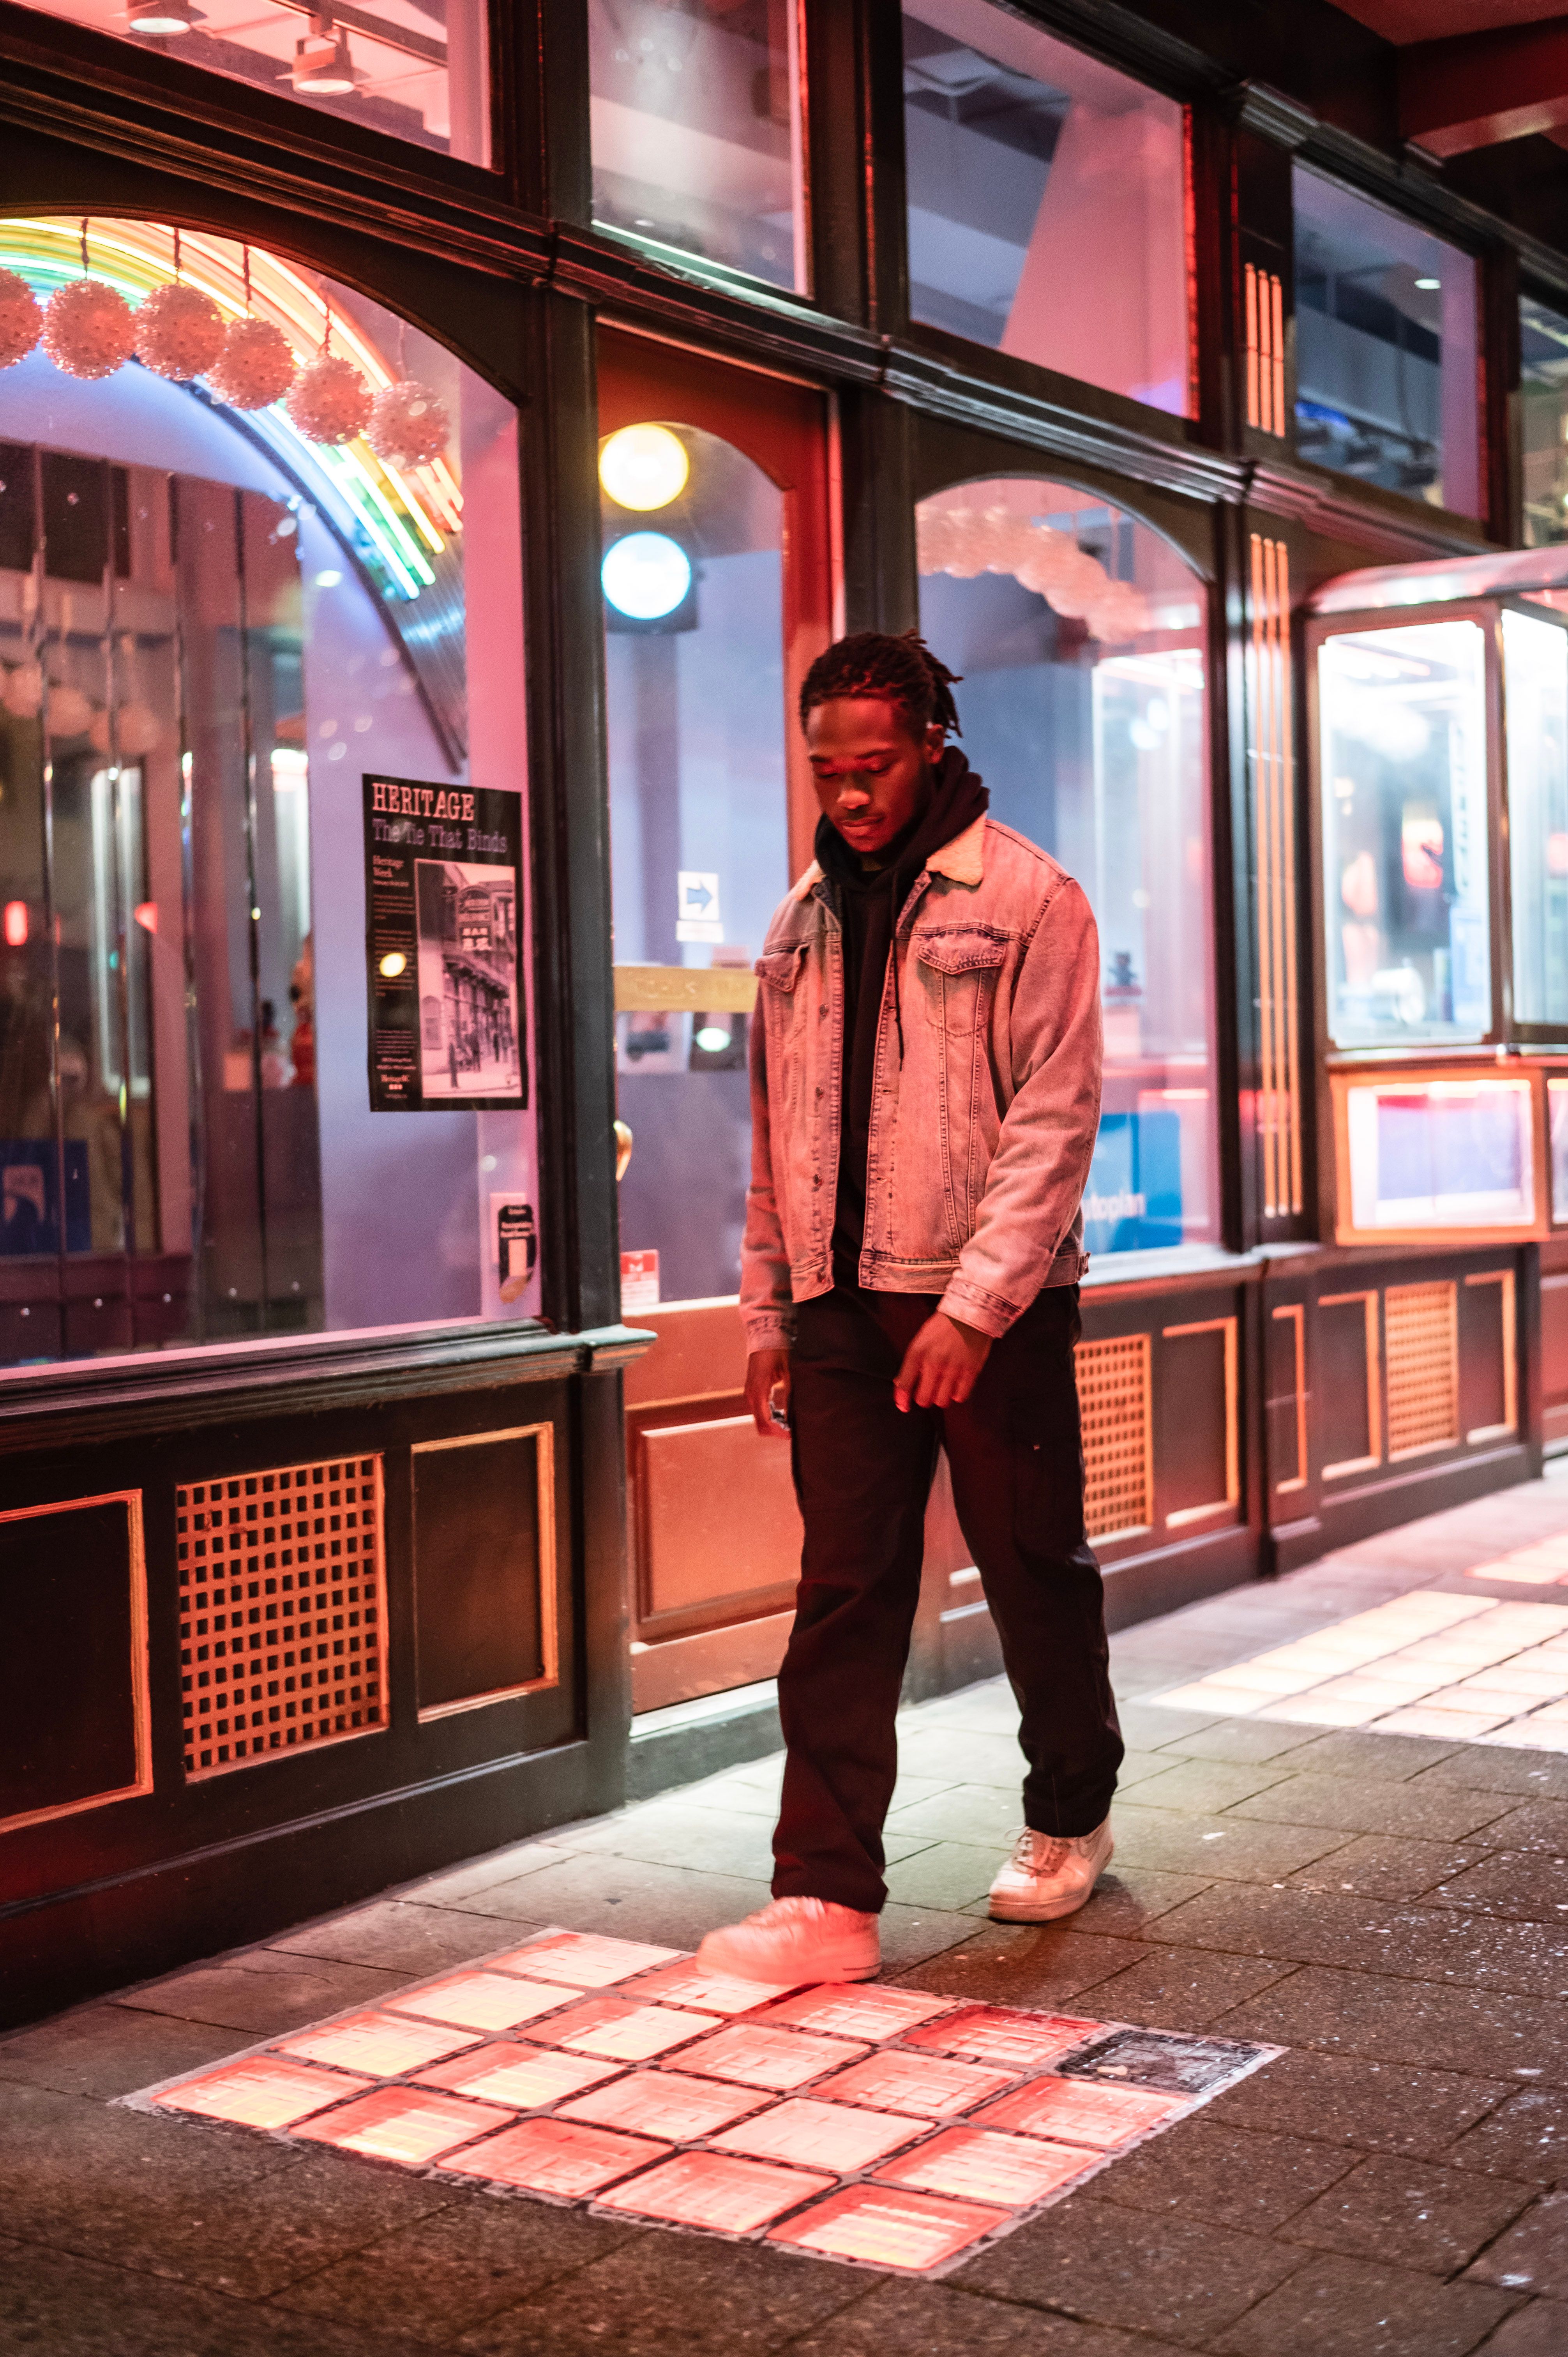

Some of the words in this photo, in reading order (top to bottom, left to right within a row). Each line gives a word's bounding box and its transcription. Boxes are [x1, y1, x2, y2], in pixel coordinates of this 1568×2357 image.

[372, 783, 475, 822] HERITAGE
[372, 818, 399, 843] The
[429, 824, 463, 849] That
[467, 828, 507, 853] Binds
[1081, 1190, 1146, 1224] utoplan
